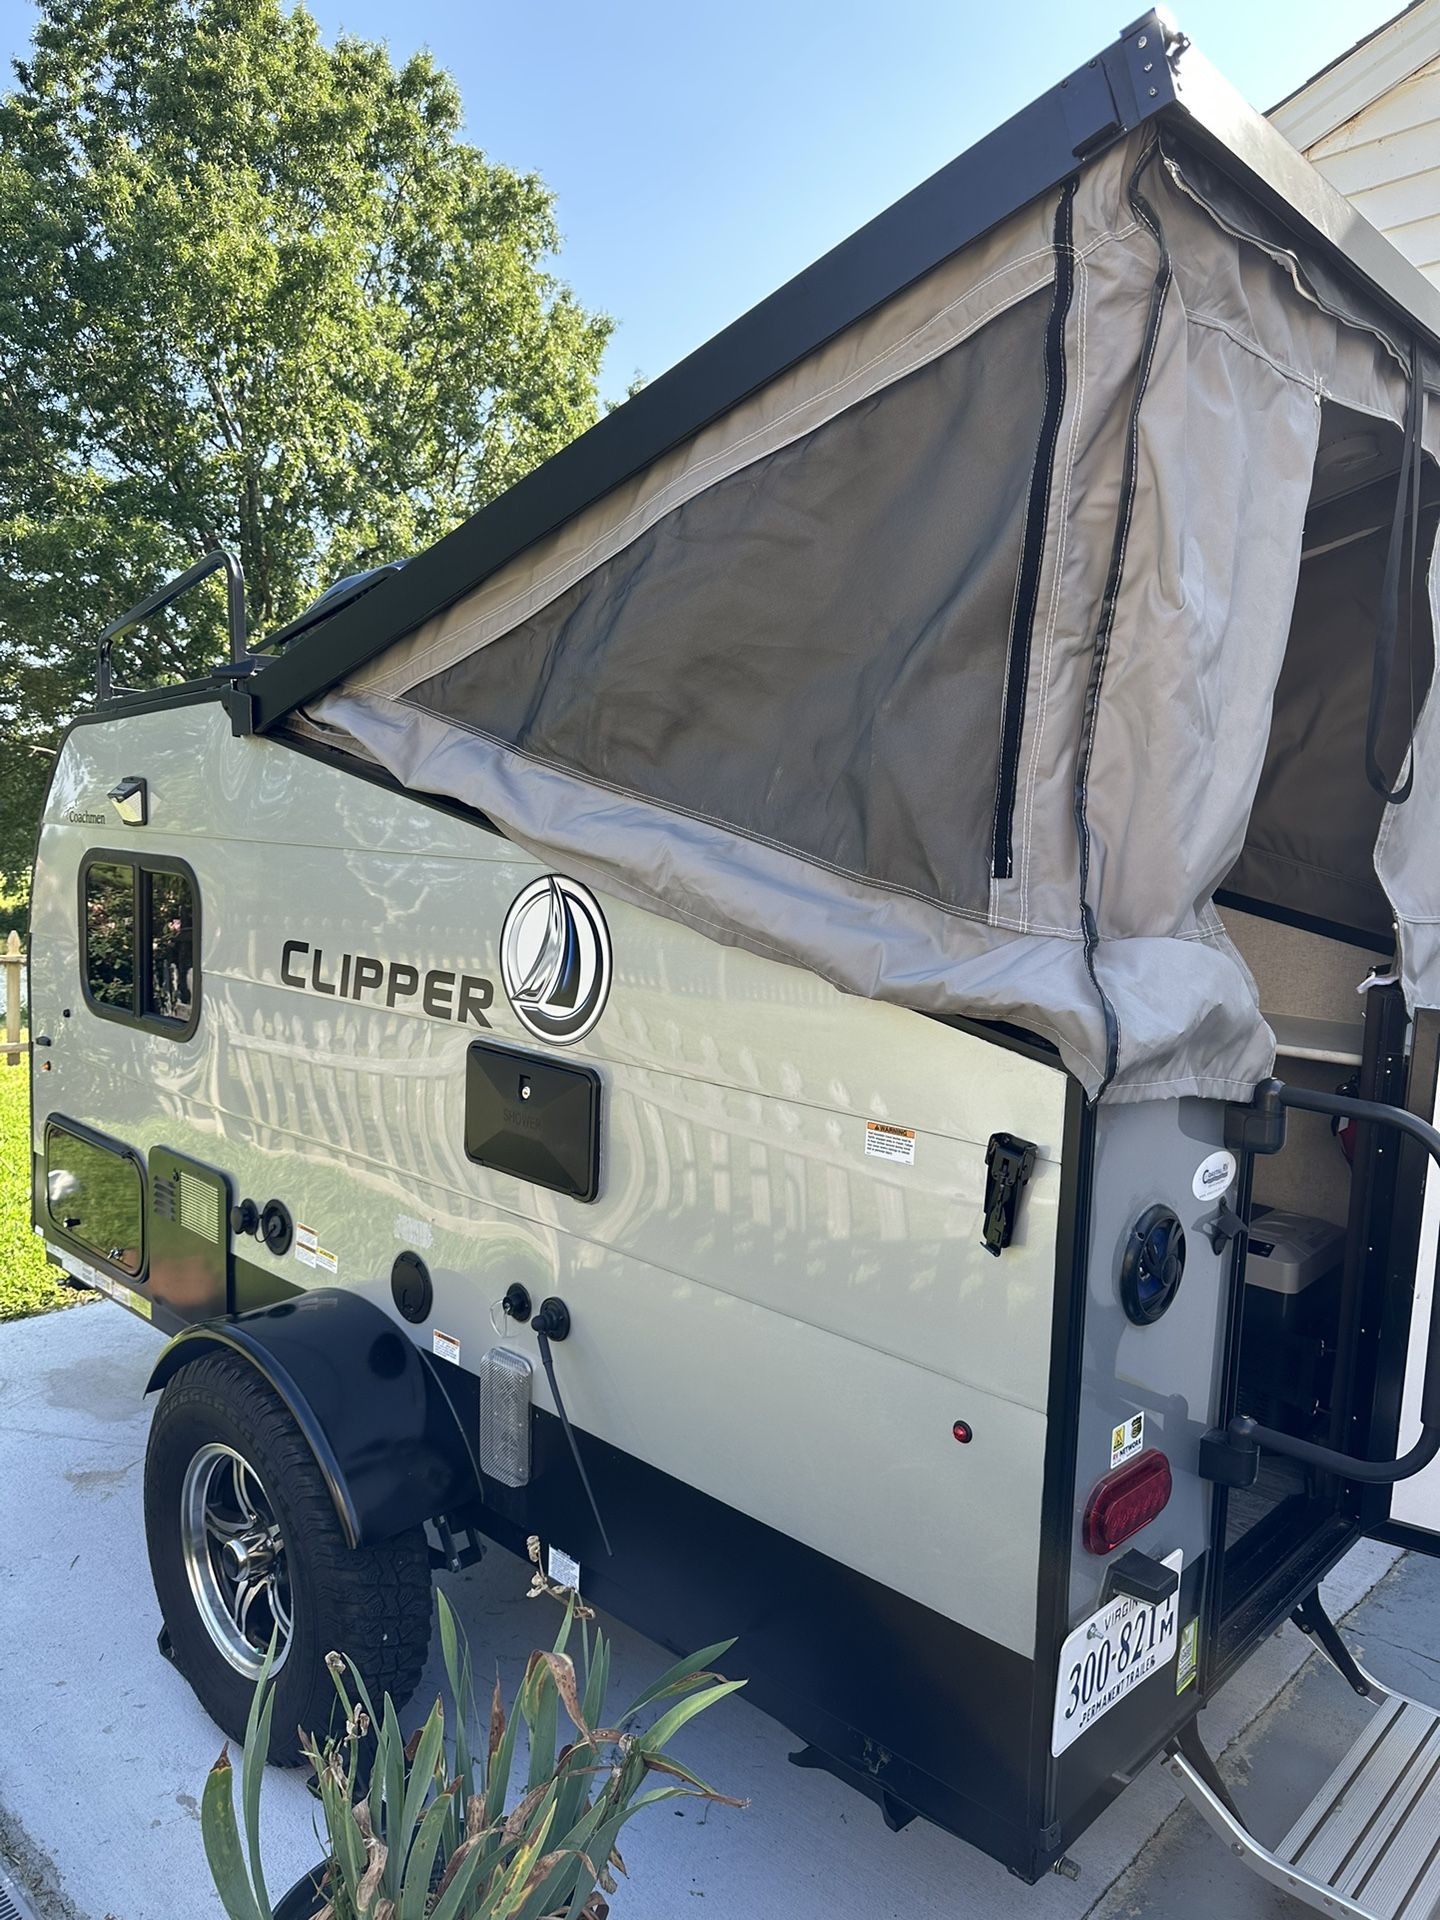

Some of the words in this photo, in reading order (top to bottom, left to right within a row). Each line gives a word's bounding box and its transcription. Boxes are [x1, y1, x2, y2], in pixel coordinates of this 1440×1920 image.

[69, 809, 106, 825] Coachmen
[280, 939, 495, 1030] CLIPPER
[503, 1109, 543, 1130] SHOWER
[879, 1125, 907, 1137] WARNING
[1065, 1605, 1156, 1718] 300-821
[1081, 1677, 1125, 1724] PERMANENT
[1124, 1654, 1156, 1688] TRAILER
